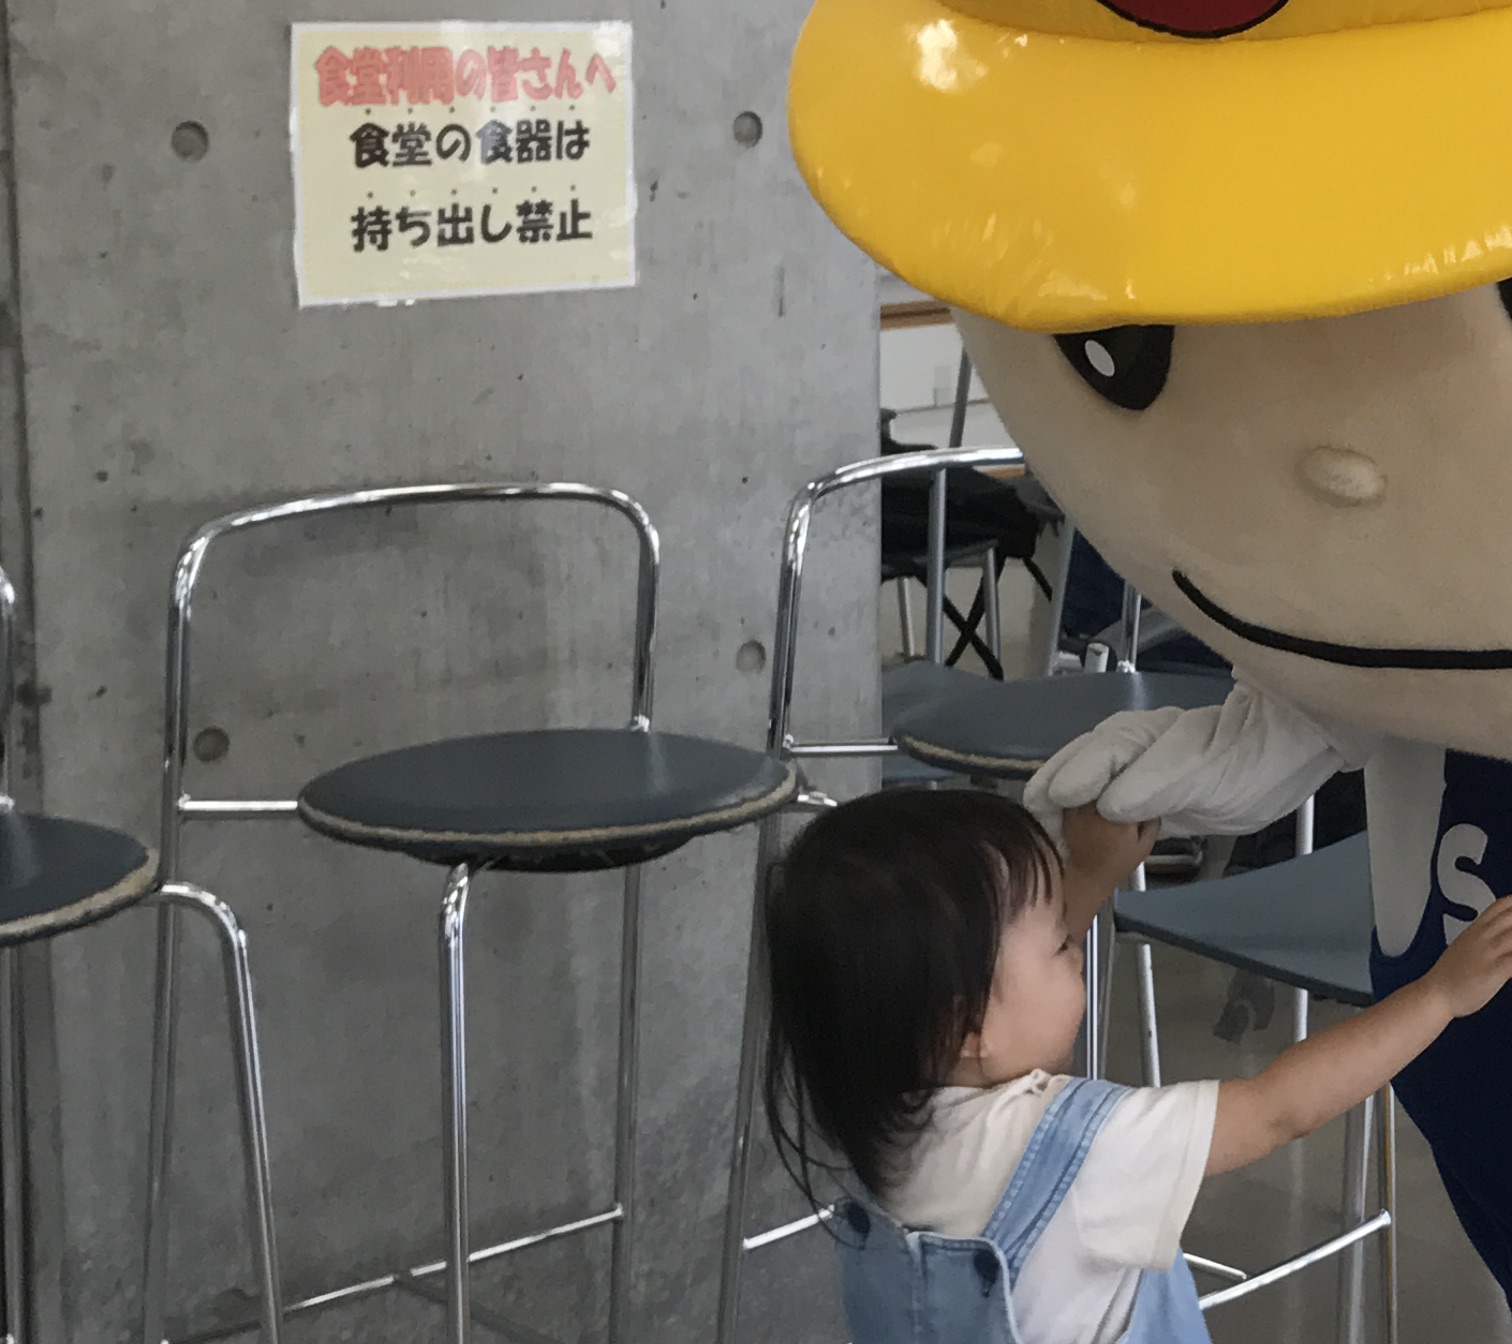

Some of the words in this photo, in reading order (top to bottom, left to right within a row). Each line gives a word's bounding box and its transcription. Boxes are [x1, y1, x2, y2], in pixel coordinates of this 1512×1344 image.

[315, 45, 616, 106] 食堂利用の皆さんへ
[349, 118, 591, 168] 食堂の食器は
[350, 198, 593, 253] 持ち出し禁止
